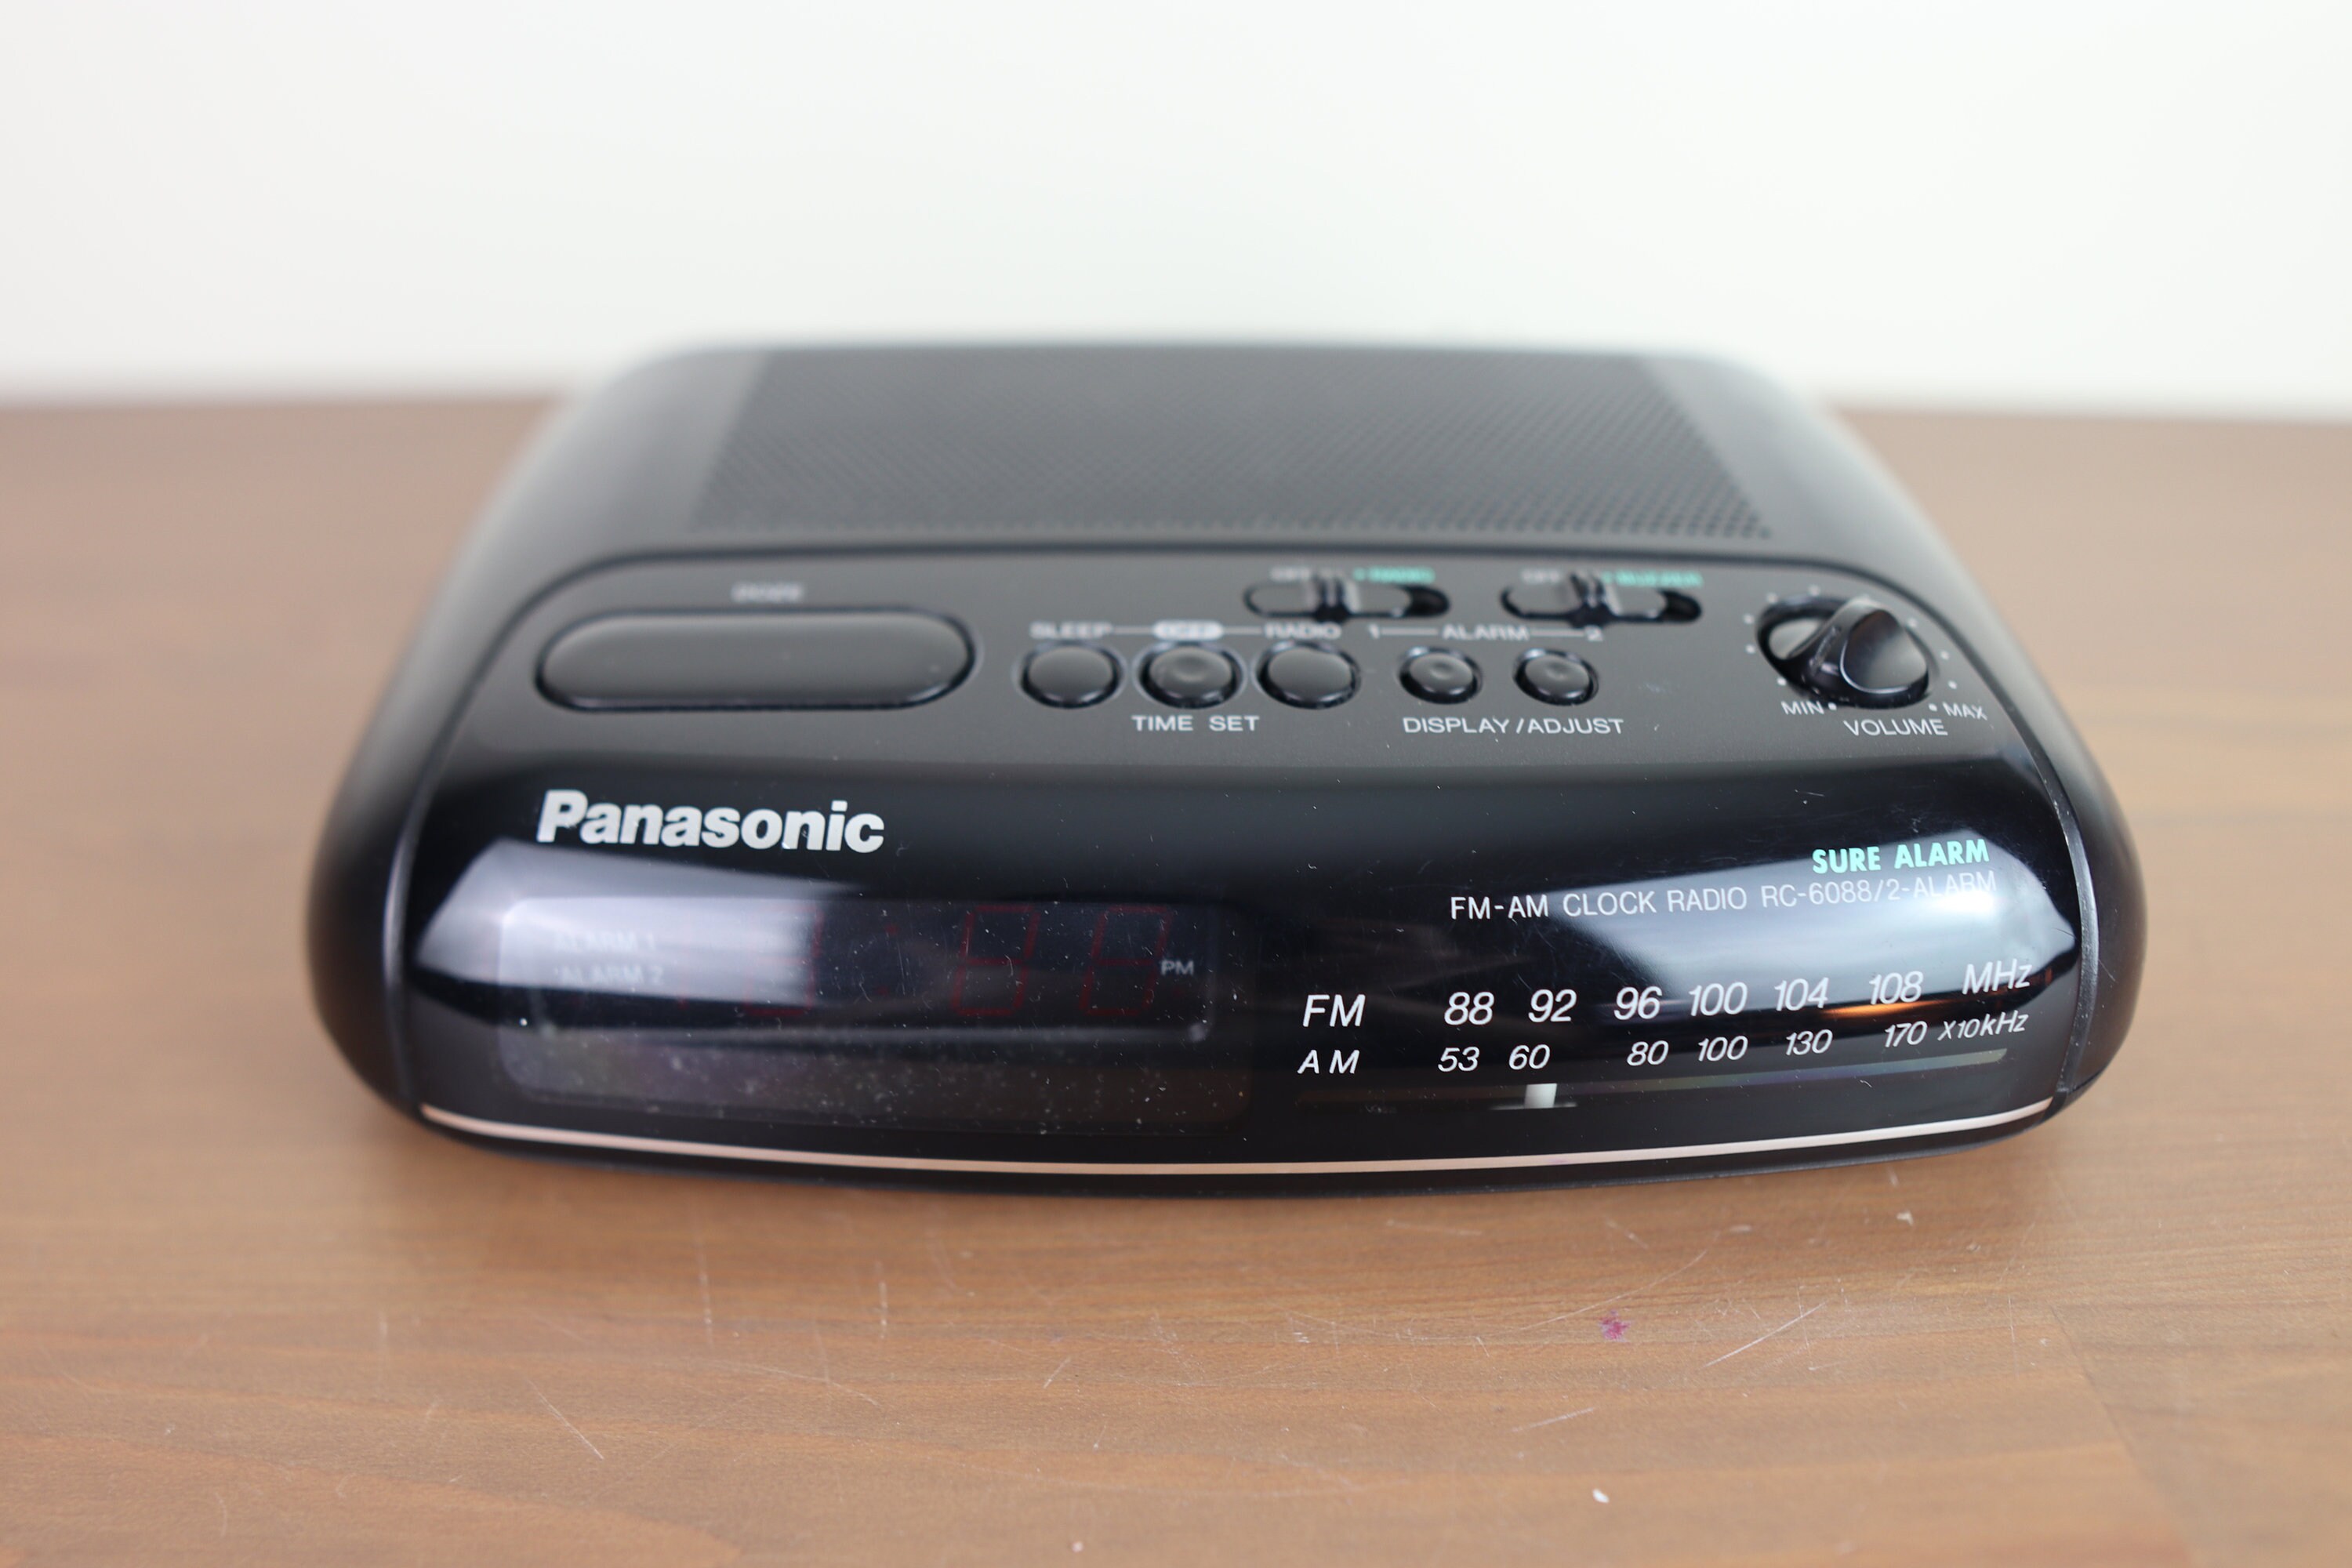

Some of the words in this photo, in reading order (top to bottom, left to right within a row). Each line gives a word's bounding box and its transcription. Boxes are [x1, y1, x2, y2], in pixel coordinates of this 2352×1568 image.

[1029, 622, 1112, 639] SLEEP
[1265, 622, 1341, 639] RADIO
[1442, 624, 1530, 641] ALARM
[1584, 625, 1604, 641] 2
[1780, 701, 1824, 715] MIN
[1942, 702, 1988, 720] MAX
[1131, 715, 1194, 732] TIME
[1209, 715, 1260, 732] SET
[1843, 718, 1948, 736] VOLUME
[536, 789, 885, 854] Panasonic
[1812, 846, 1882, 874] SURE
[1893, 839, 1990, 869] ALARM
[1450, 894, 1549, 920] FM-AM
[1563, 891, 1657, 917] CLOCK
[1666, 887, 1748, 913] RADIO
[1761, 869, 1997, 908] RC-6088/2-ALARM
[1160, 959, 1195, 976] PM
[1302, 993, 1367, 1028] FM
[1443, 991, 1495, 1026] 88
[1528, 988, 1577, 1024] 92
[1613, 985, 1663, 1021] 96
[1689, 982, 1748, 1017] 100
[1774, 977, 1830, 1012] 104
[1868, 970, 1924, 1005] 108
[1962, 958, 2033, 996] MHz
[1297, 1049, 1360, 1075] AM
[1437, 1046, 1480, 1073] 53
[1508, 1044, 1551, 1071] 60
[1626, 1040, 1670, 1067] 80
[1697, 1035, 1749, 1062] 100
[1785, 1029, 1834, 1057] 130
[1884, 1021, 1928, 1048] 170
